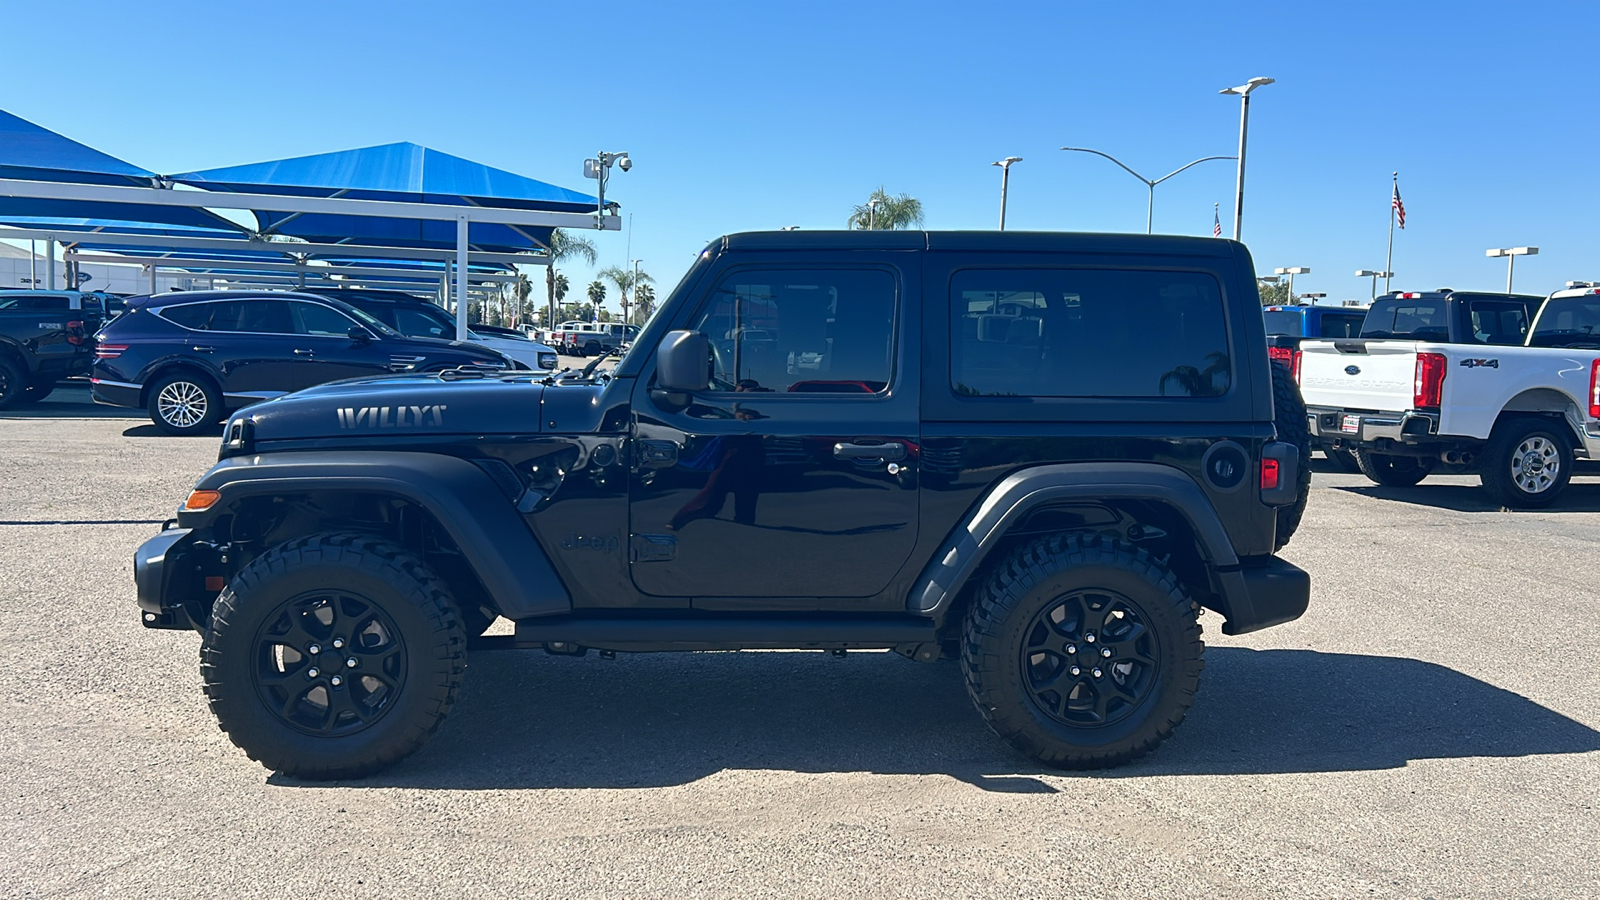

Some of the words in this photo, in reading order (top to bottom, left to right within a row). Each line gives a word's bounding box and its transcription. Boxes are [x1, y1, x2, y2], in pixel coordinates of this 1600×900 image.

[1305, 377, 1357, 387] SUPER
[1360, 379, 1407, 389] DUTY
[337, 404, 447, 429] WILLYS
[561, 531, 618, 553] Jeep
